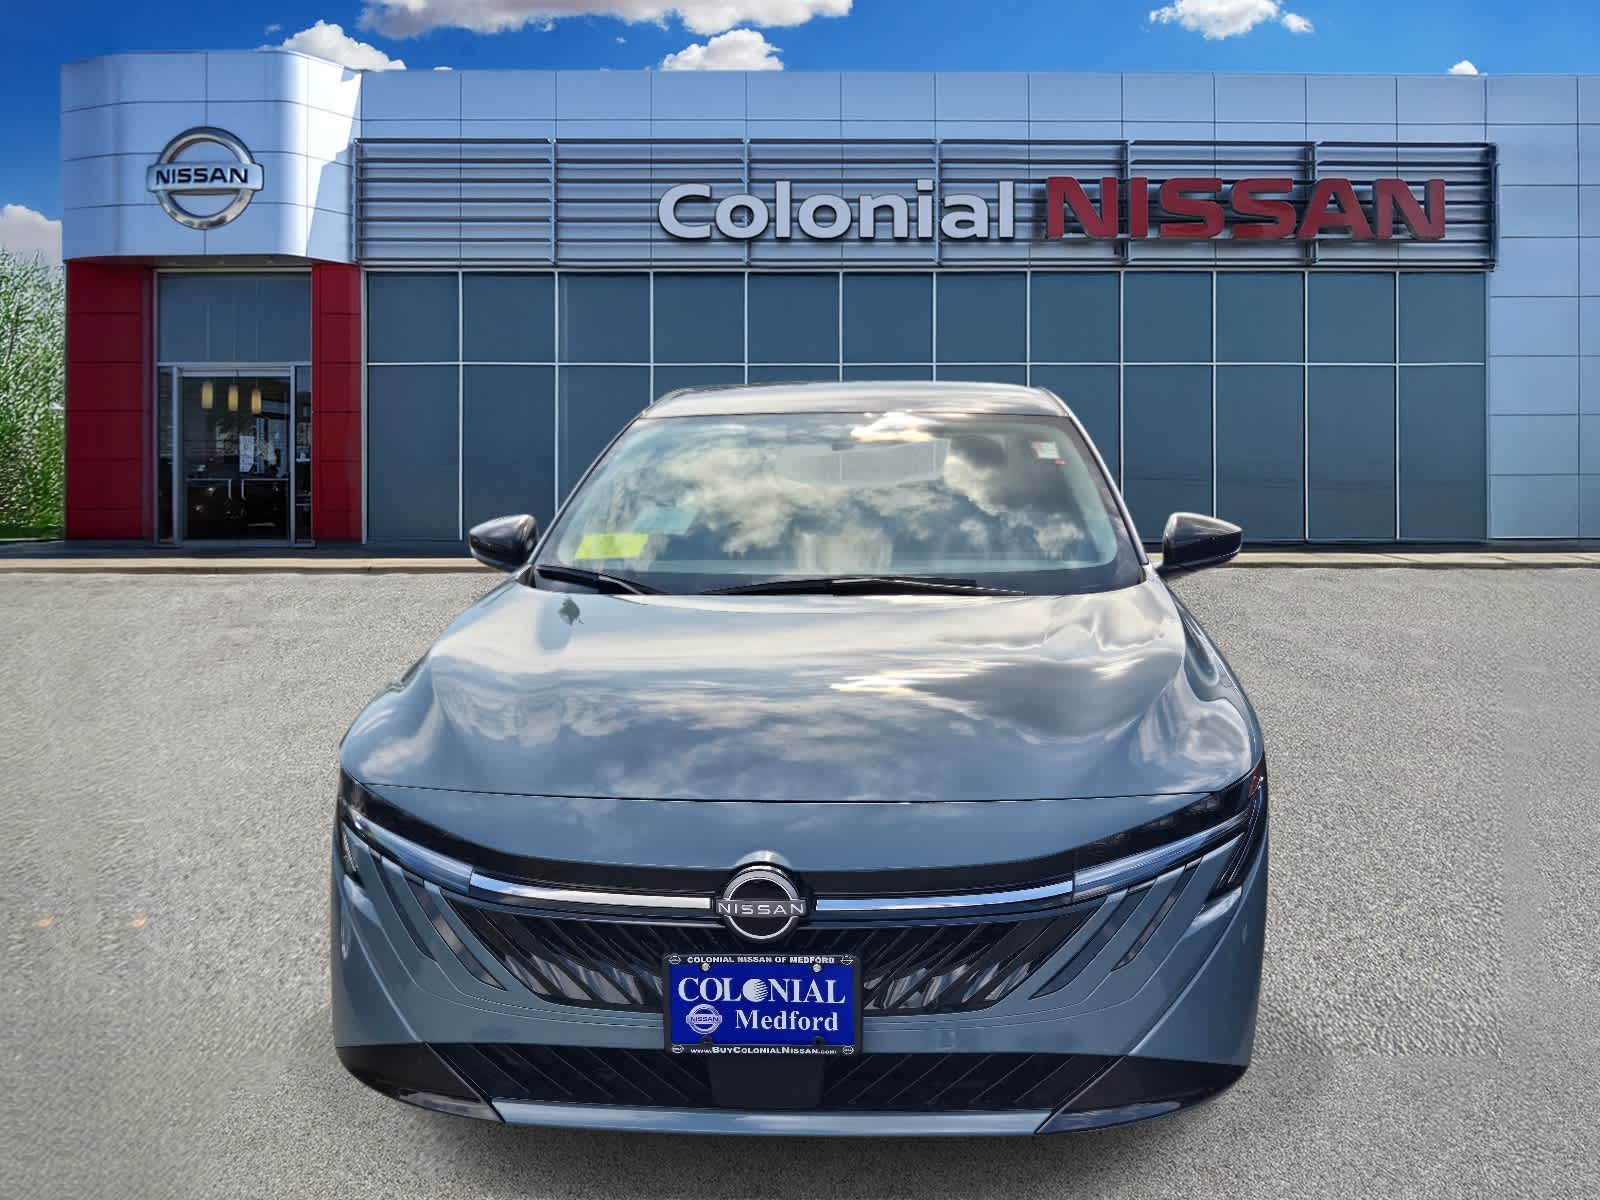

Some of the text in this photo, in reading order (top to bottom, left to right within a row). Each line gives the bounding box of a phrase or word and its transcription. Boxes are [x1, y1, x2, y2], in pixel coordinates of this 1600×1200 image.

[155, 167, 249, 185] NISSAN
[658, 176, 1446, 240] Colonial NISSAN
[718, 902, 805, 915] NISSAN
[687, 956, 835, 965] COLONIAL NISSAN OF MEDFORD
[678, 977, 846, 1004] COLONIAL
[735, 1009, 839, 1031] Medford
